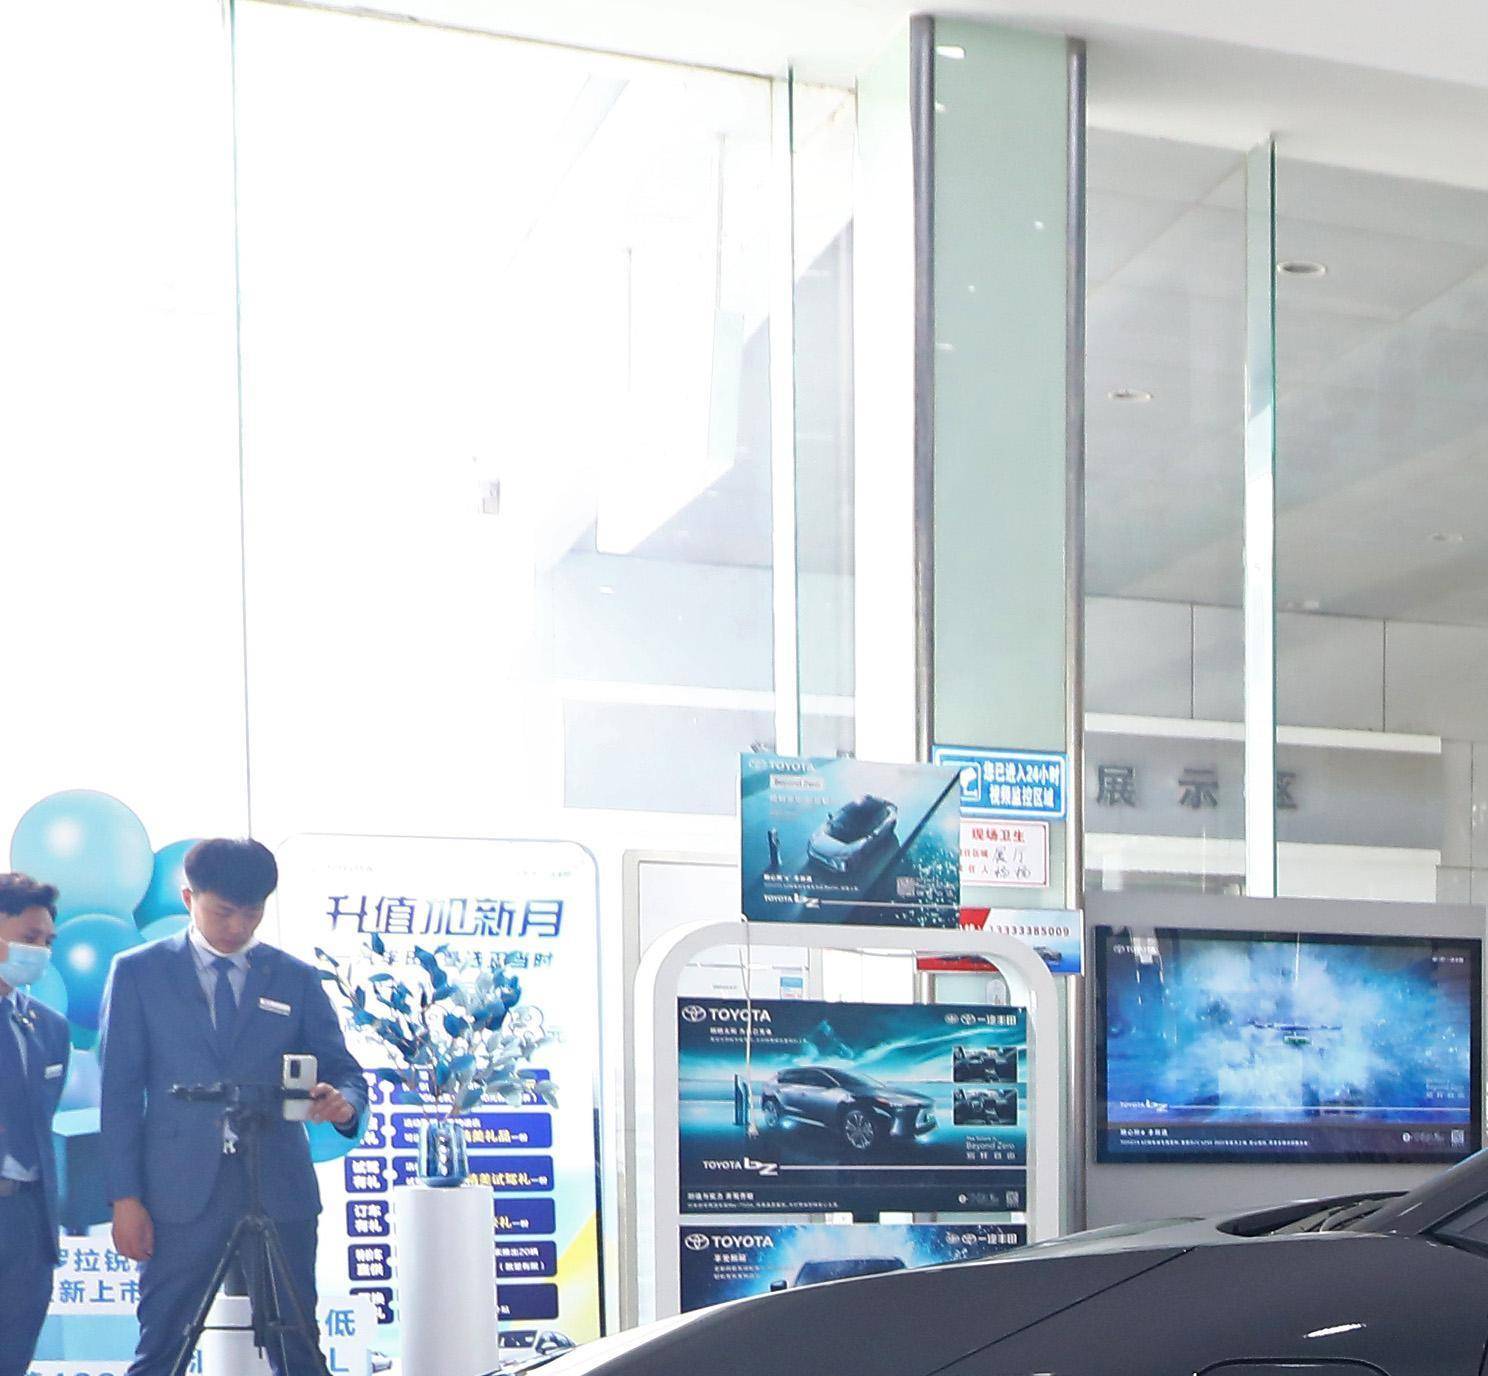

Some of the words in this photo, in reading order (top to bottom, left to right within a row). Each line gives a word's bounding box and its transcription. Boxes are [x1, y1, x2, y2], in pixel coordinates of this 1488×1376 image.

[769, 760, 816, 772] TOYOTA
[983, 761, 1060, 787] 您已进入24小时
[989, 784, 1055, 808] 视频监控区域
[972, 828, 1025, 843] 现场卫生
[708, 1008, 771, 1023] TOYOTA
[703, 1160, 743, 1170] TOYOTA
[710, 1235, 774, 1249] TOYOTA
